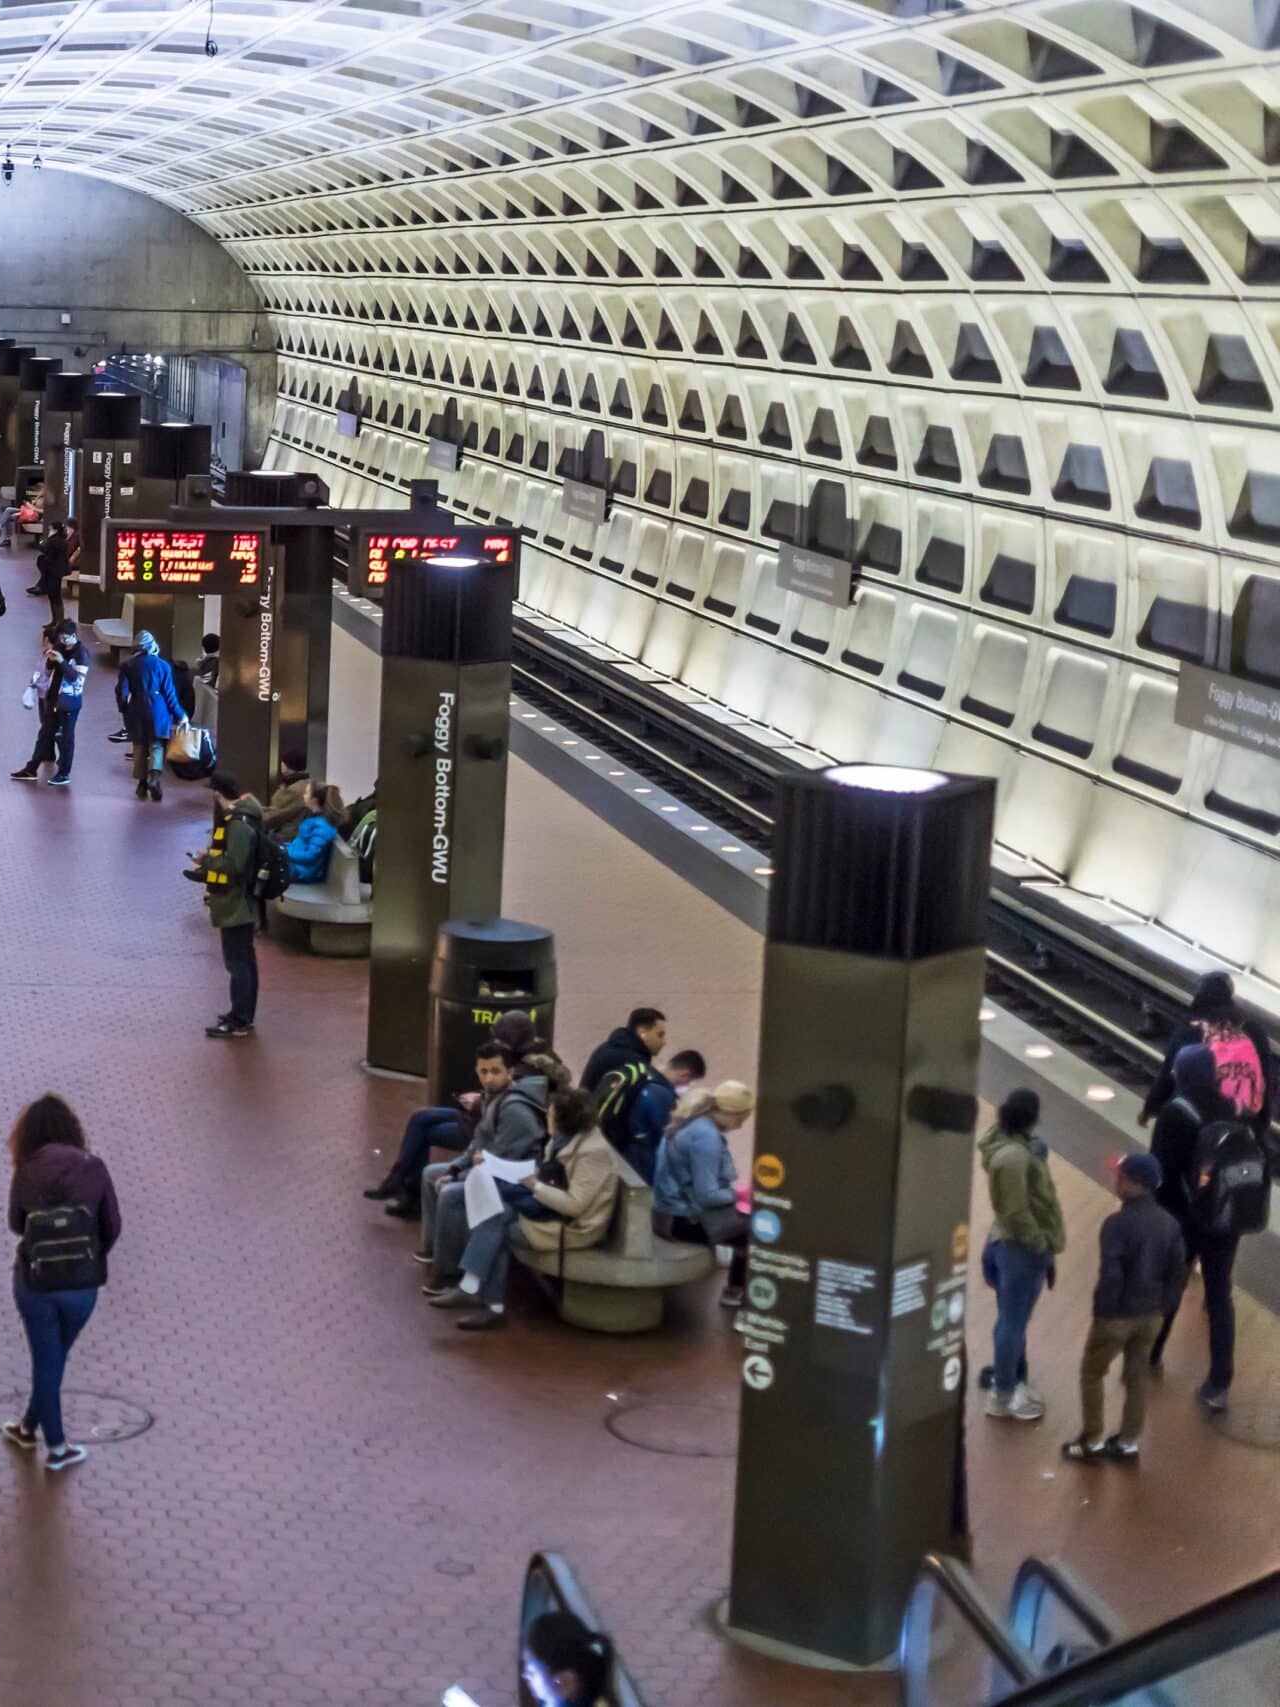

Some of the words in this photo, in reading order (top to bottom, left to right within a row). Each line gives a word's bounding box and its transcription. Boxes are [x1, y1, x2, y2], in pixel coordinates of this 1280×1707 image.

[104, 452, 113, 480] Foggy
[104, 481, 113, 519] Bottom-
[258, 612, 272, 702] Bottom-GWU
[1207, 681, 1235, 712] Foggy
[434, 692, 455, 753] Foggy
[431, 758, 452, 884] Bottom-GWU
